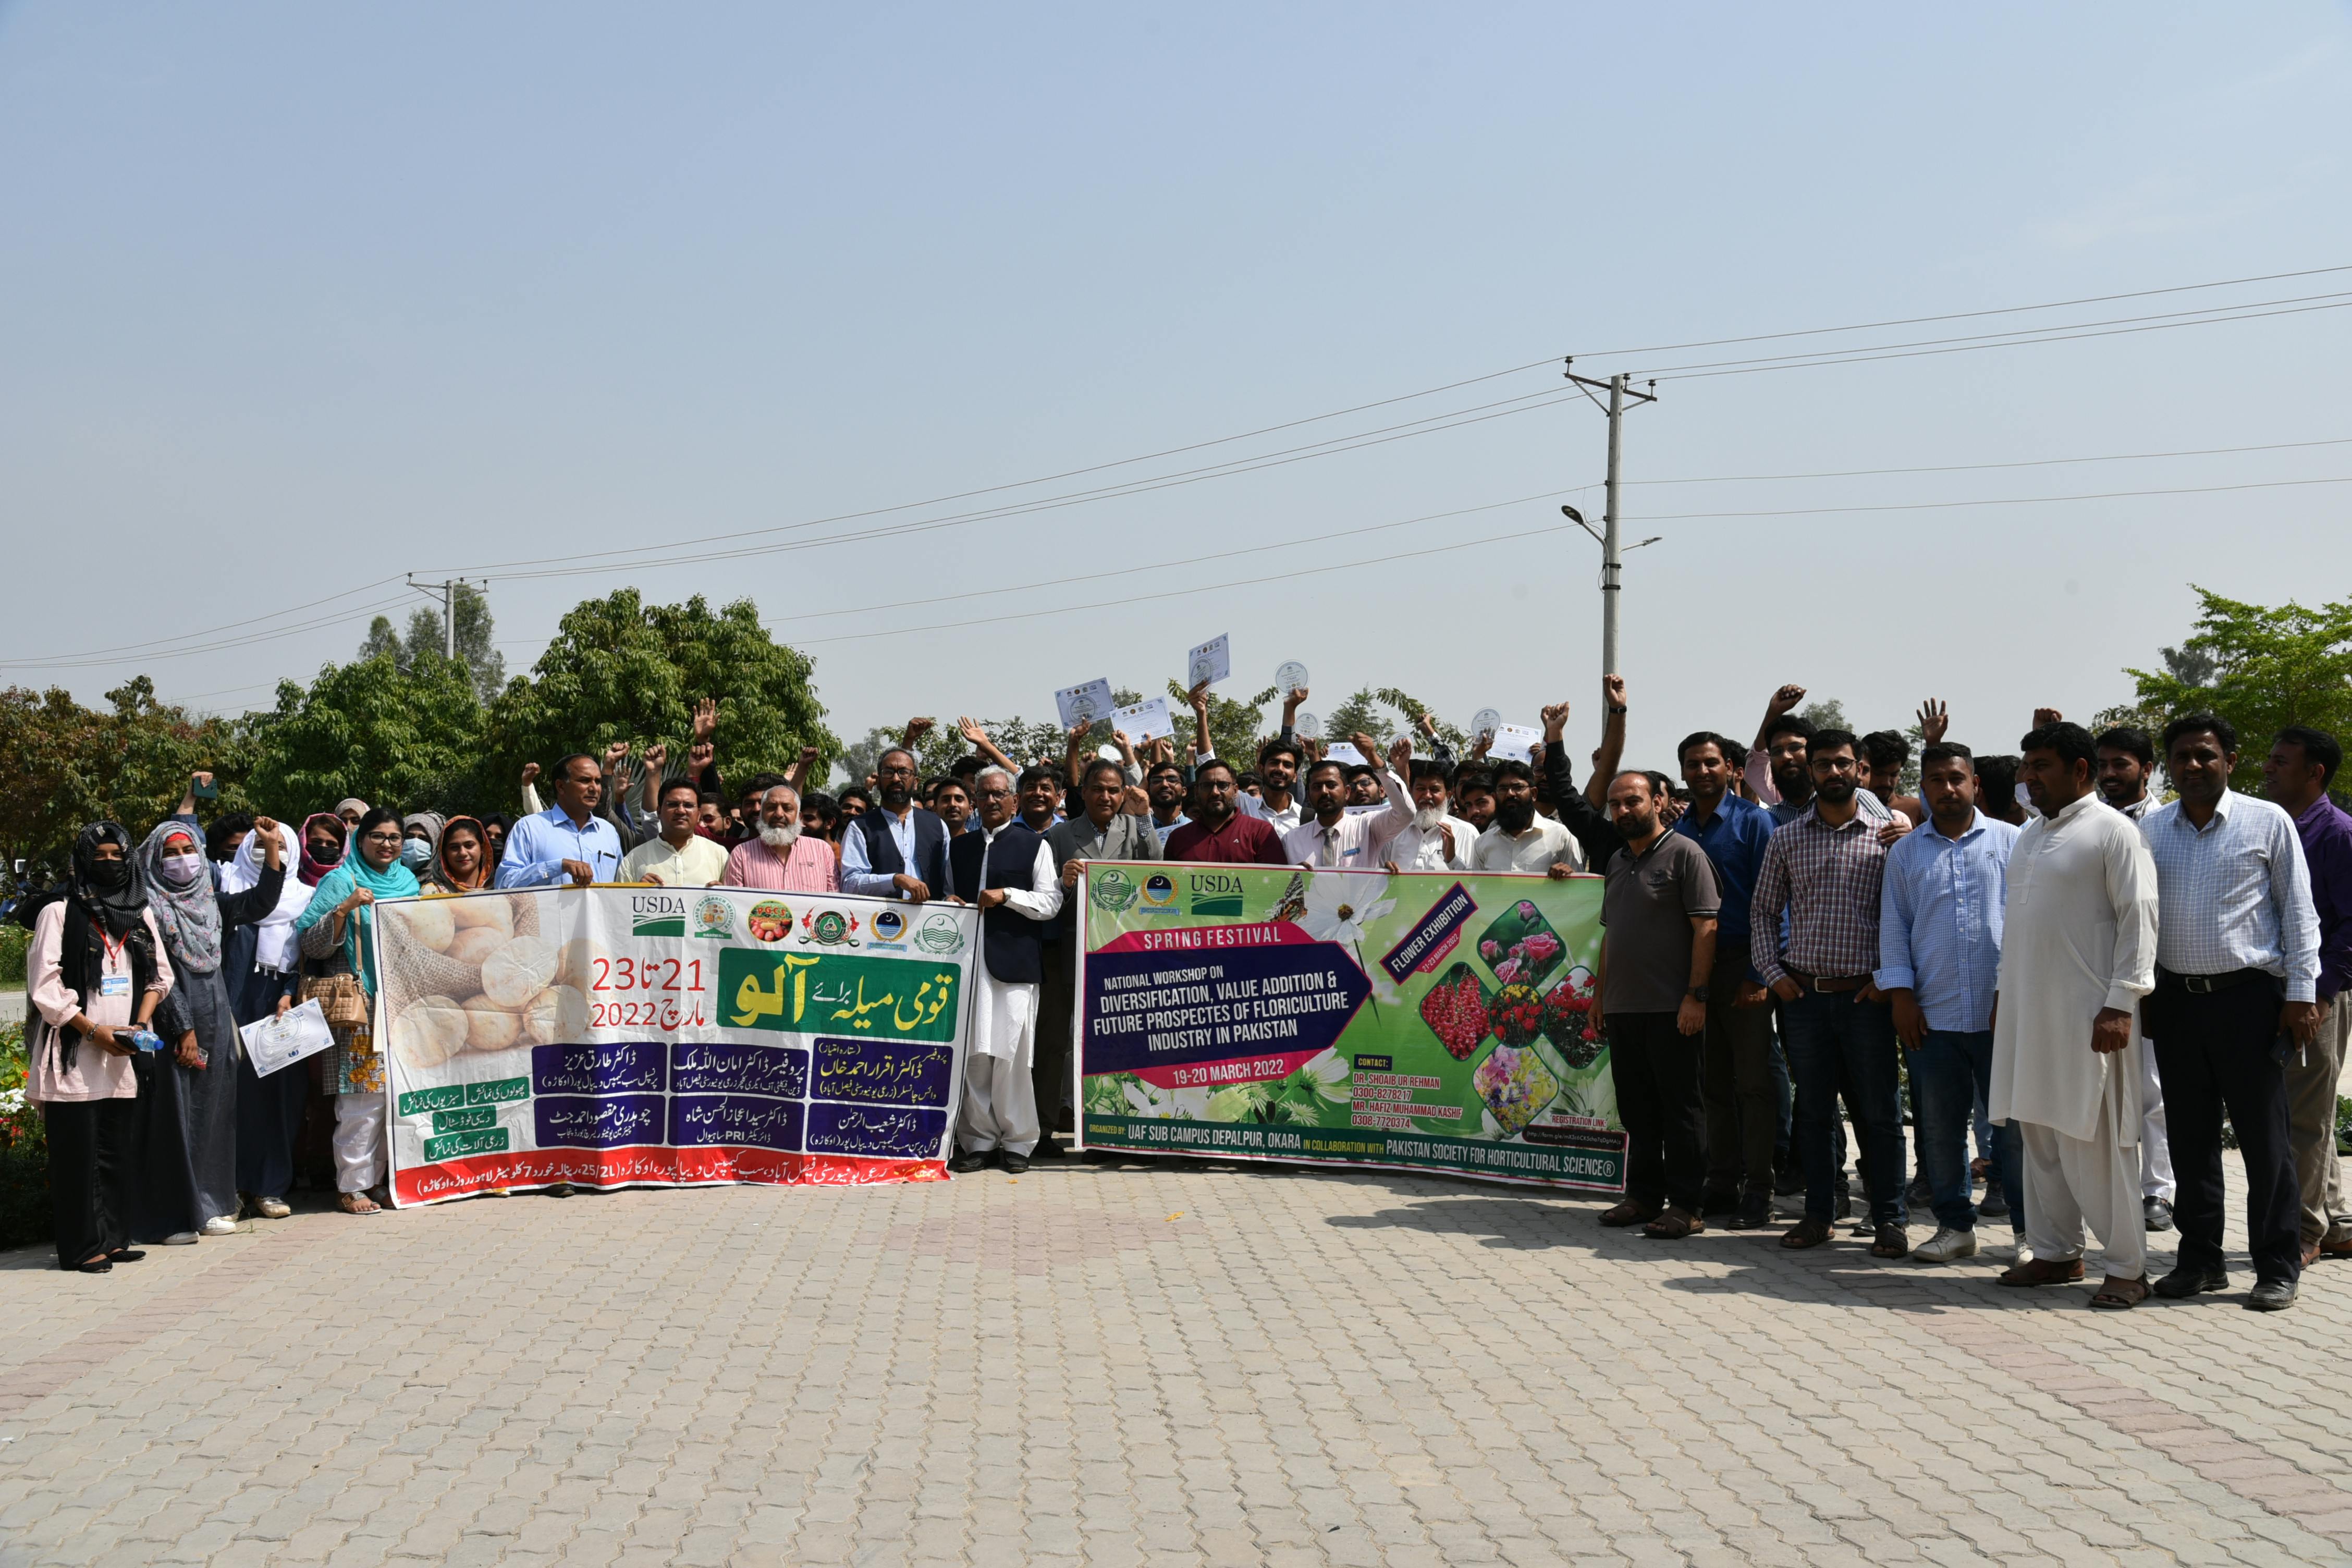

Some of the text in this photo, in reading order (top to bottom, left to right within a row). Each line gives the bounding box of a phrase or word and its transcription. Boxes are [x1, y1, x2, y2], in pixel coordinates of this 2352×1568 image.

[1191, 875, 1244, 892] USDA
[632, 896, 686, 913] USDA
[1144, 926, 1281, 949] SPRING FESTIVAL
[1391, 893, 1468, 973] FLOWER EXHIBITION
[1422, 933, 1459, 972] 21-23 MARCH 2022
[593, 957, 705, 991] 21 تا 23
[1104, 965, 1223, 990] NATIONAL WORKSHOP ON
[730, 953, 953, 1031] قومی میلہ برائے آلو
[1100, 971, 1337, 1013] DIVERSIFICATION, VALUE ADDITION &
[592, 998, 705, 1031] مارچ 2022
[1094, 991, 1349, 1035] FUTURE PROSPECTES OF FLORICULTURE
[1148, 1019, 1298, 1051] INDUSTRY IN PAKISTAN
[1173, 1059, 1284, 1085] 19-20 MARCH 2022
[1358, 1058, 1389, 1068] CONTACT:
[1353, 1073, 1440, 1089] DR. SHOAIB UR REHMAN
[1353, 1087, 1412, 1100] 0300-8278217
[1352, 1101, 1462, 1119] MR. HAFIZ MUHAMMAD KASHIF
[1352, 1114, 1411, 1129] 0308-7720374
[1552, 1115, 1607, 1128] REGISTRATION LINK:
[725, 1131, 744, 1141] PRI
[1089, 1124, 1117, 1134] ORGANIZED
[1128, 1124, 1146, 1140] UAF
[1149, 1125, 1169, 1141] SUB
[1171, 1126, 1210, 1144] CAMPUS
[1212, 1130, 1265, 1149] DEPALPUR,
[1268, 1132, 1301, 1148] OKARA
[1303, 1139, 1310, 1150] IN
[1312, 1140, 1366, 1153] COLLABORATION
[1367, 1142, 1384, 1154] WITH
[1387, 1140, 1430, 1158] PAKISTAN
[1432, 1143, 1468, 1161] SOCIETY
[1470, 1147, 1485, 1164] FOR
[1488, 1149, 1561, 1172] HORTICULTURAL
